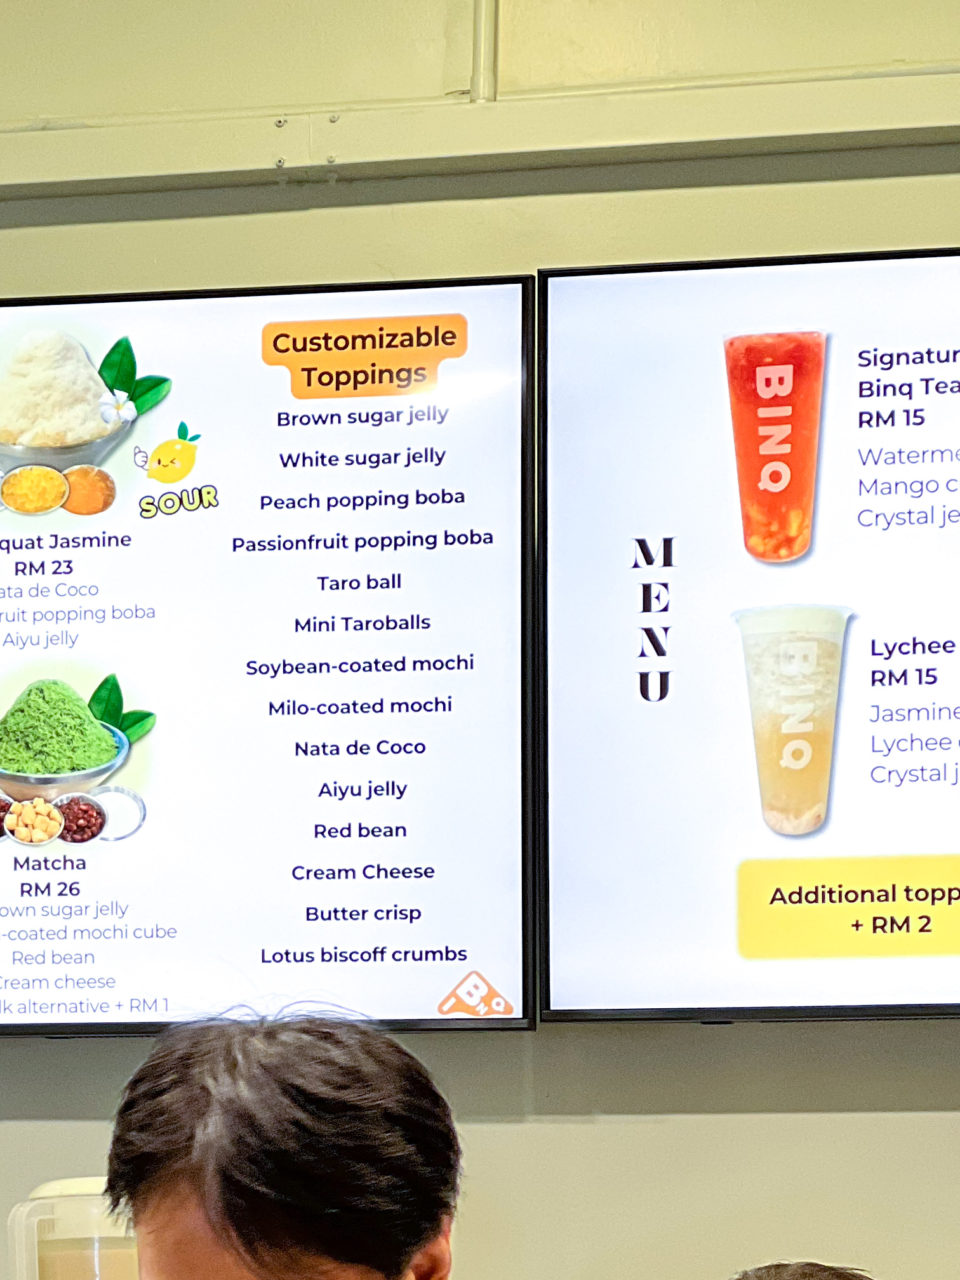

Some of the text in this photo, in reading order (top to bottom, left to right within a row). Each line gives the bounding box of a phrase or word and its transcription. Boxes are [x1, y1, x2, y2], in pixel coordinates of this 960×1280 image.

[272, 326, 458, 354] Customizable
[301, 361, 428, 391] Toppings
[859, 377, 960, 400] Binq Tea
[277, 405, 449, 427] Brown sugar jelly
[858, 408, 925, 429] RM 15
[756, 364, 795, 493] BINQ
[279, 447, 446, 469] White sugar jelly
[859, 479, 939, 498] Mango
[138, 484, 219, 519] SOUR
[260, 488, 465, 512] Peach popping boba
[858, 505, 934, 531] Crystal
[232, 529, 493, 552] Passionfruit popping boba
[15, 560, 73, 576] RM 23
[28, 583, 50, 597] de
[55, 583, 99, 597] Coco
[317, 573, 401, 591] Taro ball
[33, 606, 105, 625] popping
[112, 604, 155, 619] boba
[295, 614, 431, 633] Mini Taroballs
[630, 537, 677, 702] MENU
[3, 630, 79, 650] Aiyu jelly
[871, 636, 956, 660] Lychee
[246, 653, 474, 679] Soybean-coated mochi
[871, 667, 938, 687] RM 15
[269, 695, 452, 716] Milo-coated mochi
[295, 740, 426, 756] Nata de Coco
[872, 733, 952, 757] Lychee
[871, 763, 946, 787] Crystal
[318, 780, 408, 801] Aiyu jelly
[314, 822, 407, 839] Red bean
[14, 854, 86, 871] Matcha
[292, 864, 435, 880] Cream Cheese
[20, 881, 80, 897] RM 26
[769, 883, 896, 905] Additional
[41, 905, 89, 920] sugar
[91, 901, 128, 919] jelly
[306, 904, 422, 924] Butter crisp
[74, 924, 128, 939] mochi
[133, 924, 177, 939] cube
[872, 915, 910, 934] RM
[918, 915, 932, 933] 2
[261, 945, 467, 963] Lotus biscoff crumbs
